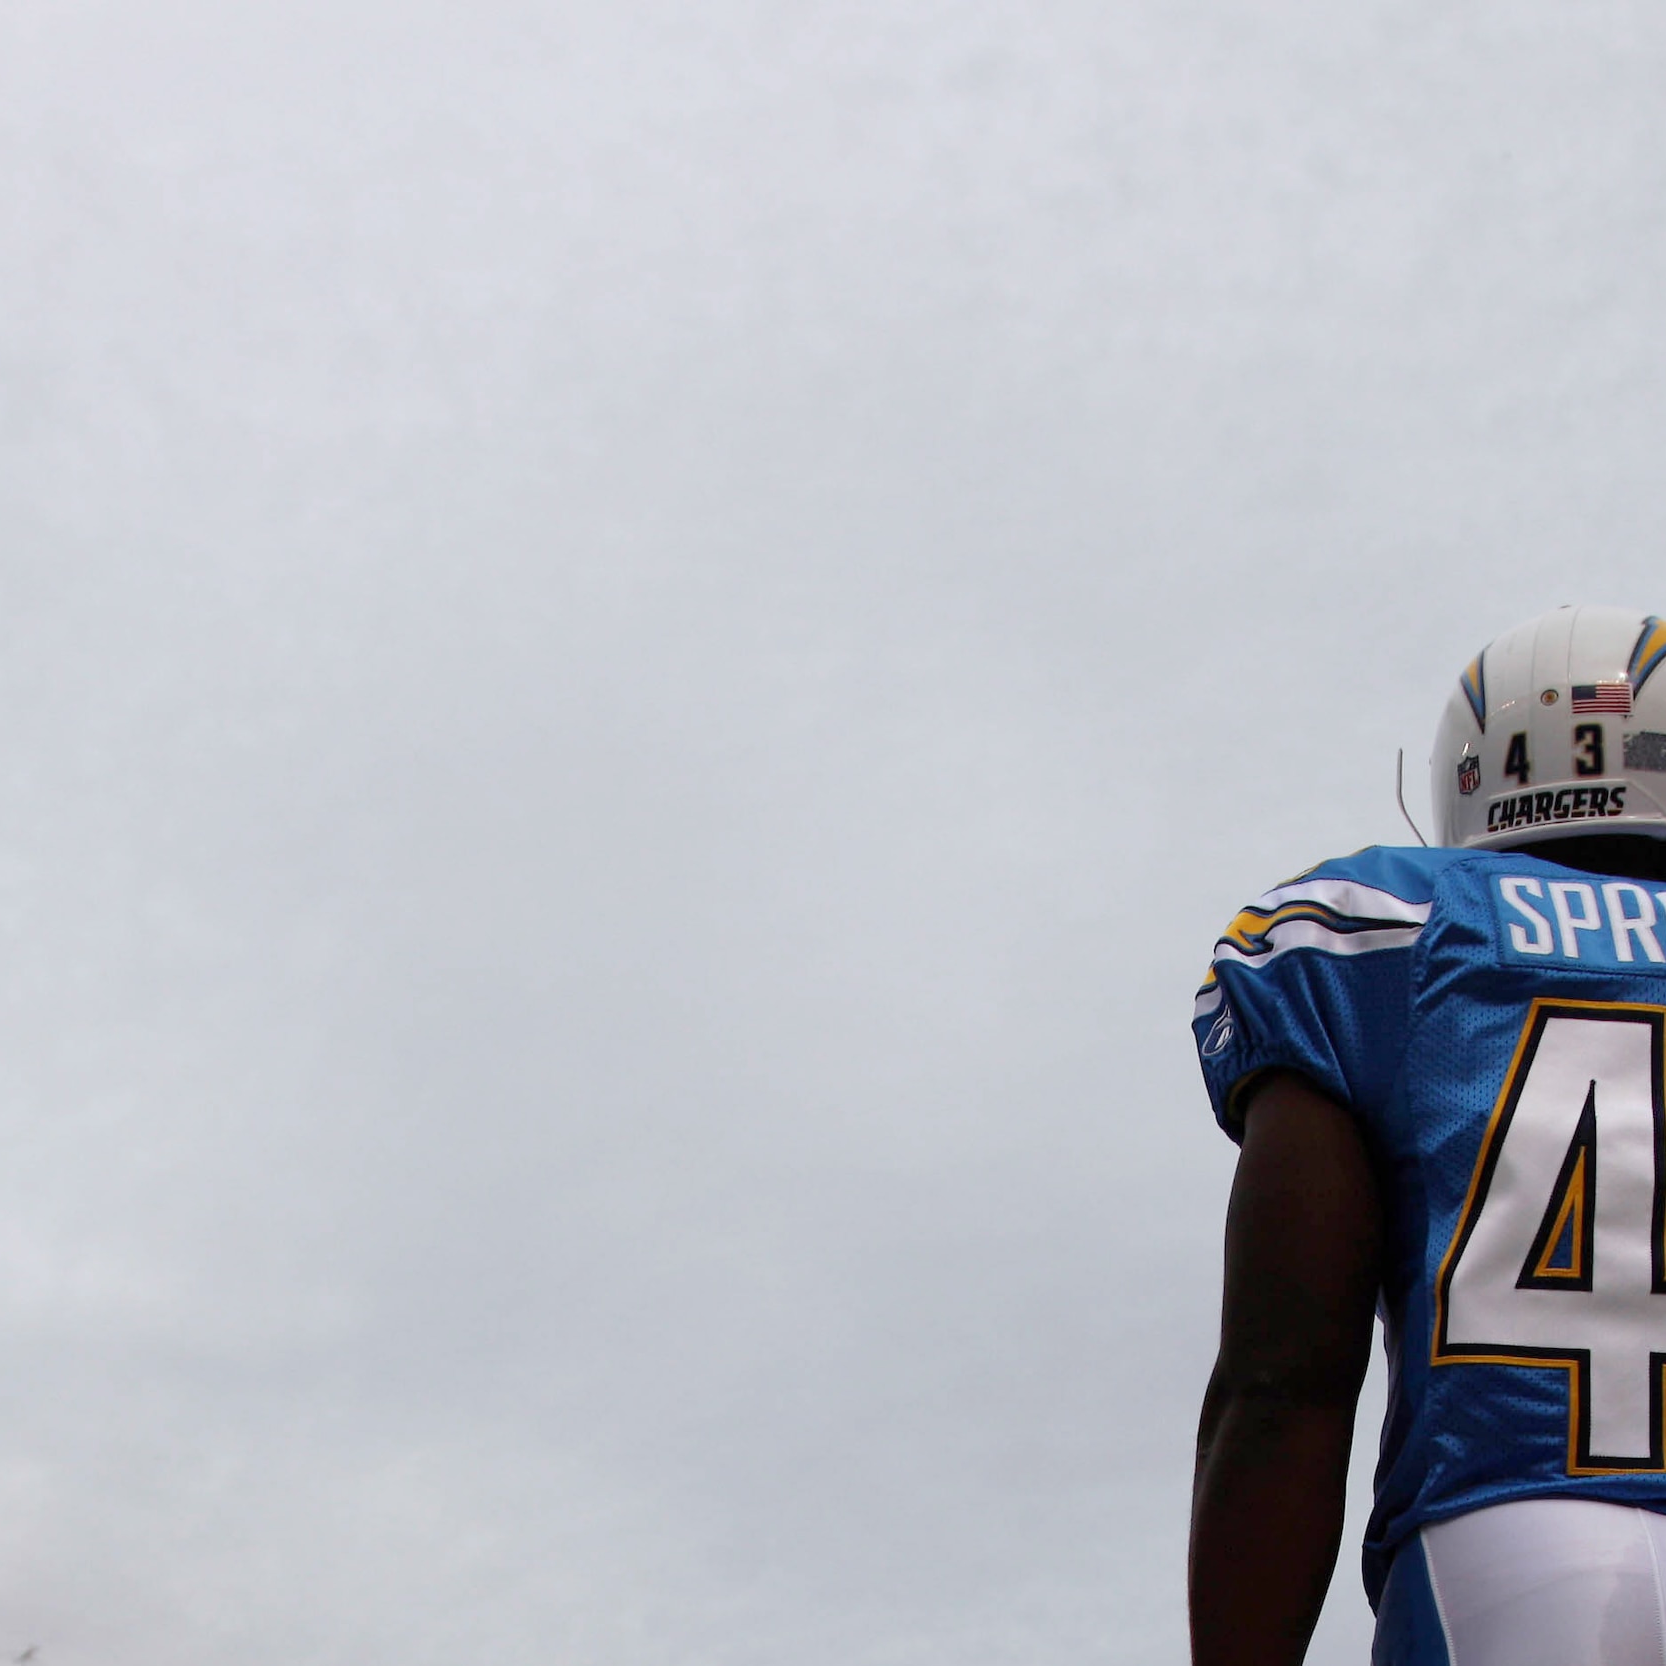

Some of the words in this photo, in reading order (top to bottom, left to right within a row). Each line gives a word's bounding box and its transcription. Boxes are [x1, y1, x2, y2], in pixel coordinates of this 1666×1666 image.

[1504, 731, 1531, 785] 4
[1574, 723, 1605, 776] 3
[1459, 771, 1479, 792] NFL
[1487, 786, 1627, 832] CHARGERS
